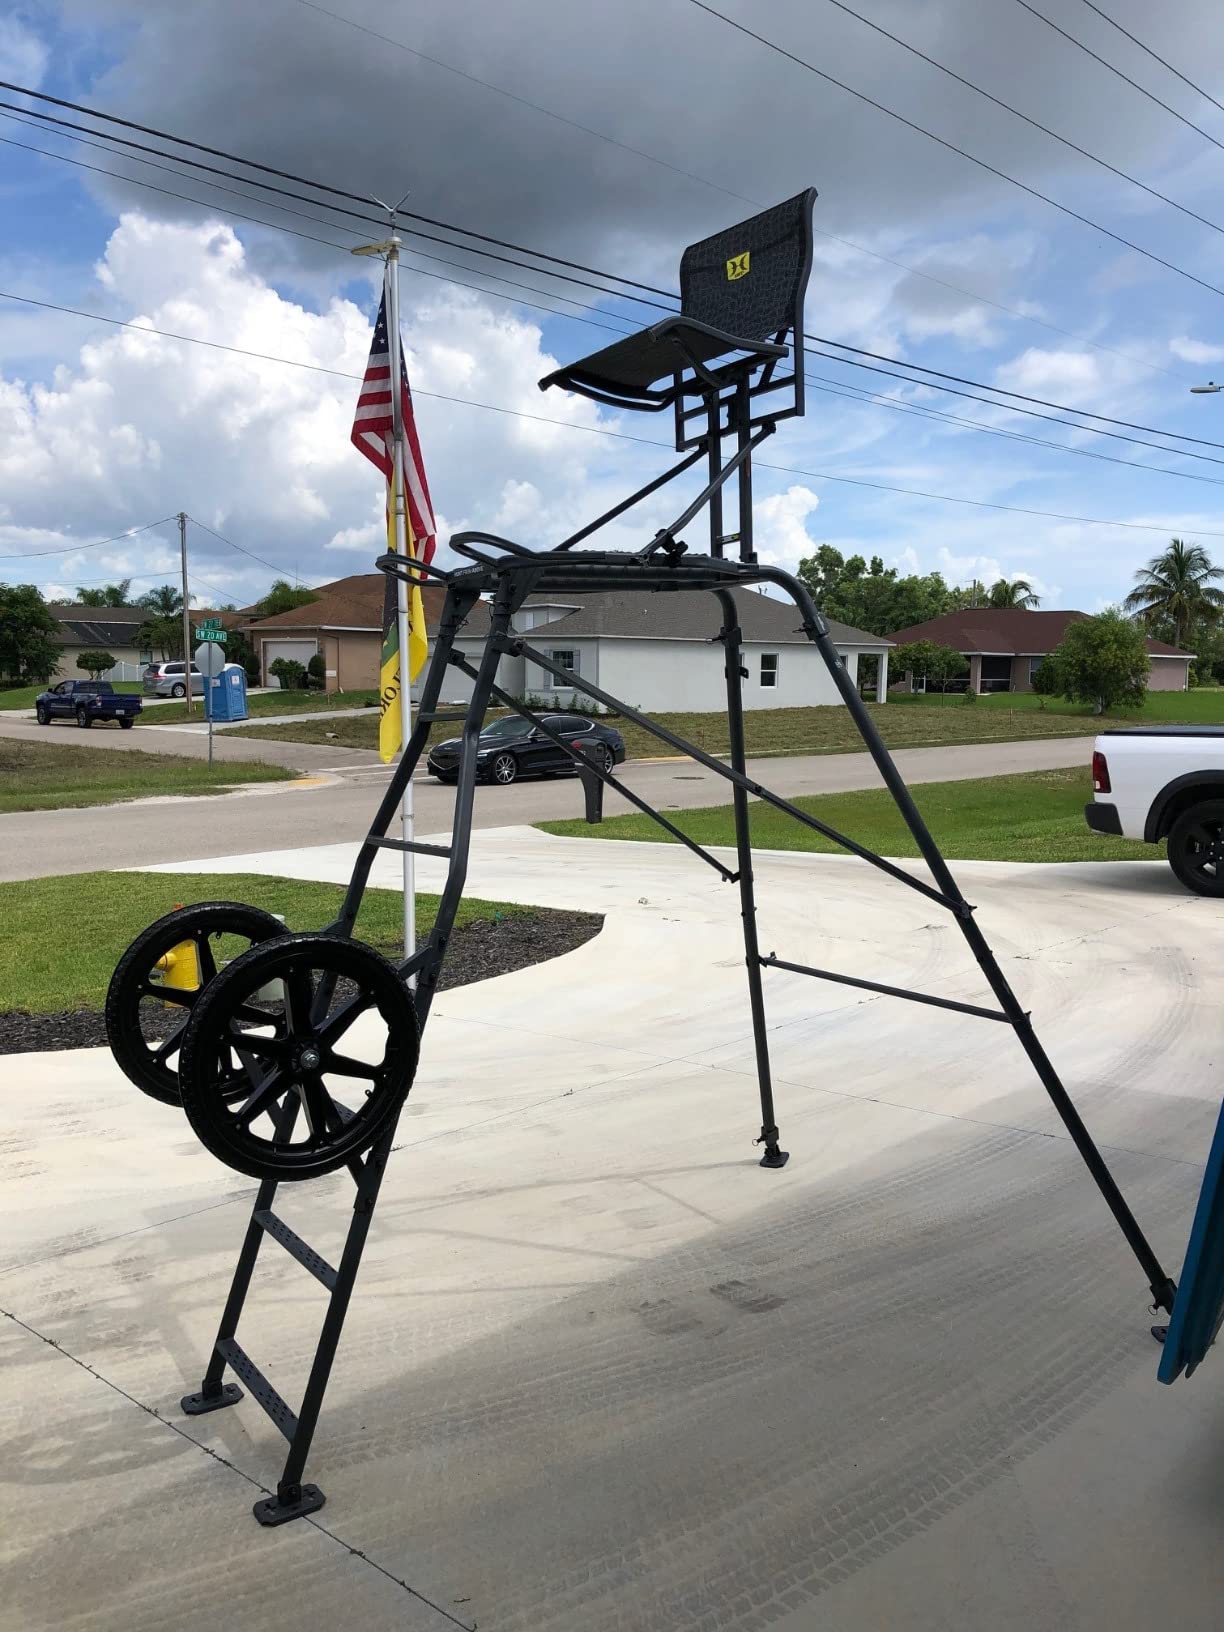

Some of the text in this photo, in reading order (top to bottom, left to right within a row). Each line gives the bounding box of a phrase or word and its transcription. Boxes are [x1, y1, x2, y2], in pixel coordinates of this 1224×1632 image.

[197, 630, 226, 641] SW 20 AVE
